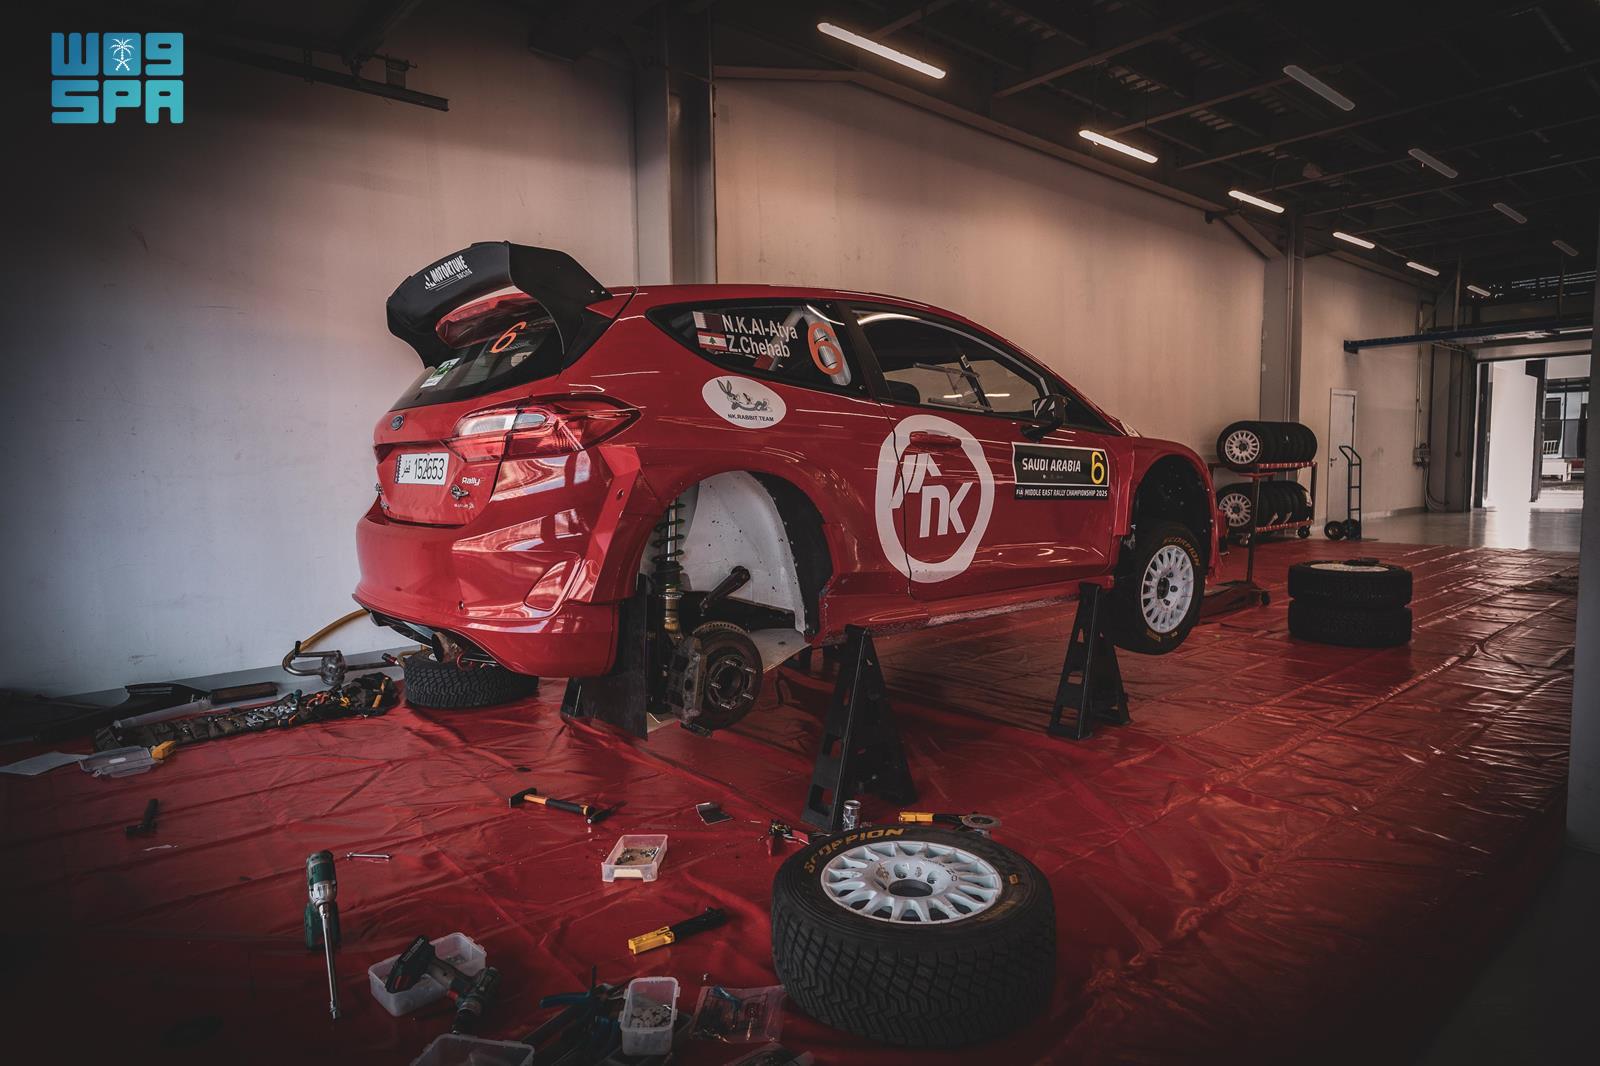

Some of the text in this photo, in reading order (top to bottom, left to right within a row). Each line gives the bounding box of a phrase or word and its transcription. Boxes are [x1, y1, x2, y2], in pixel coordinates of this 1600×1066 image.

[490, 321, 527, 354] 6
[721, 314, 799, 342] N.K.Al-Atya
[726, 334, 791, 359] Z.Chehab
[807, 322, 844, 376] 6
[758, 415, 775, 423] TEAM
[414, 458, 445, 480] 152653
[1022, 457, 1081, 473] SAUDI ARABIA
[1091, 451, 1105, 485] 6
[1066, 489, 1096, 497] CHAMPIONSHIP
[803, 828, 905, 875] SCORPION
